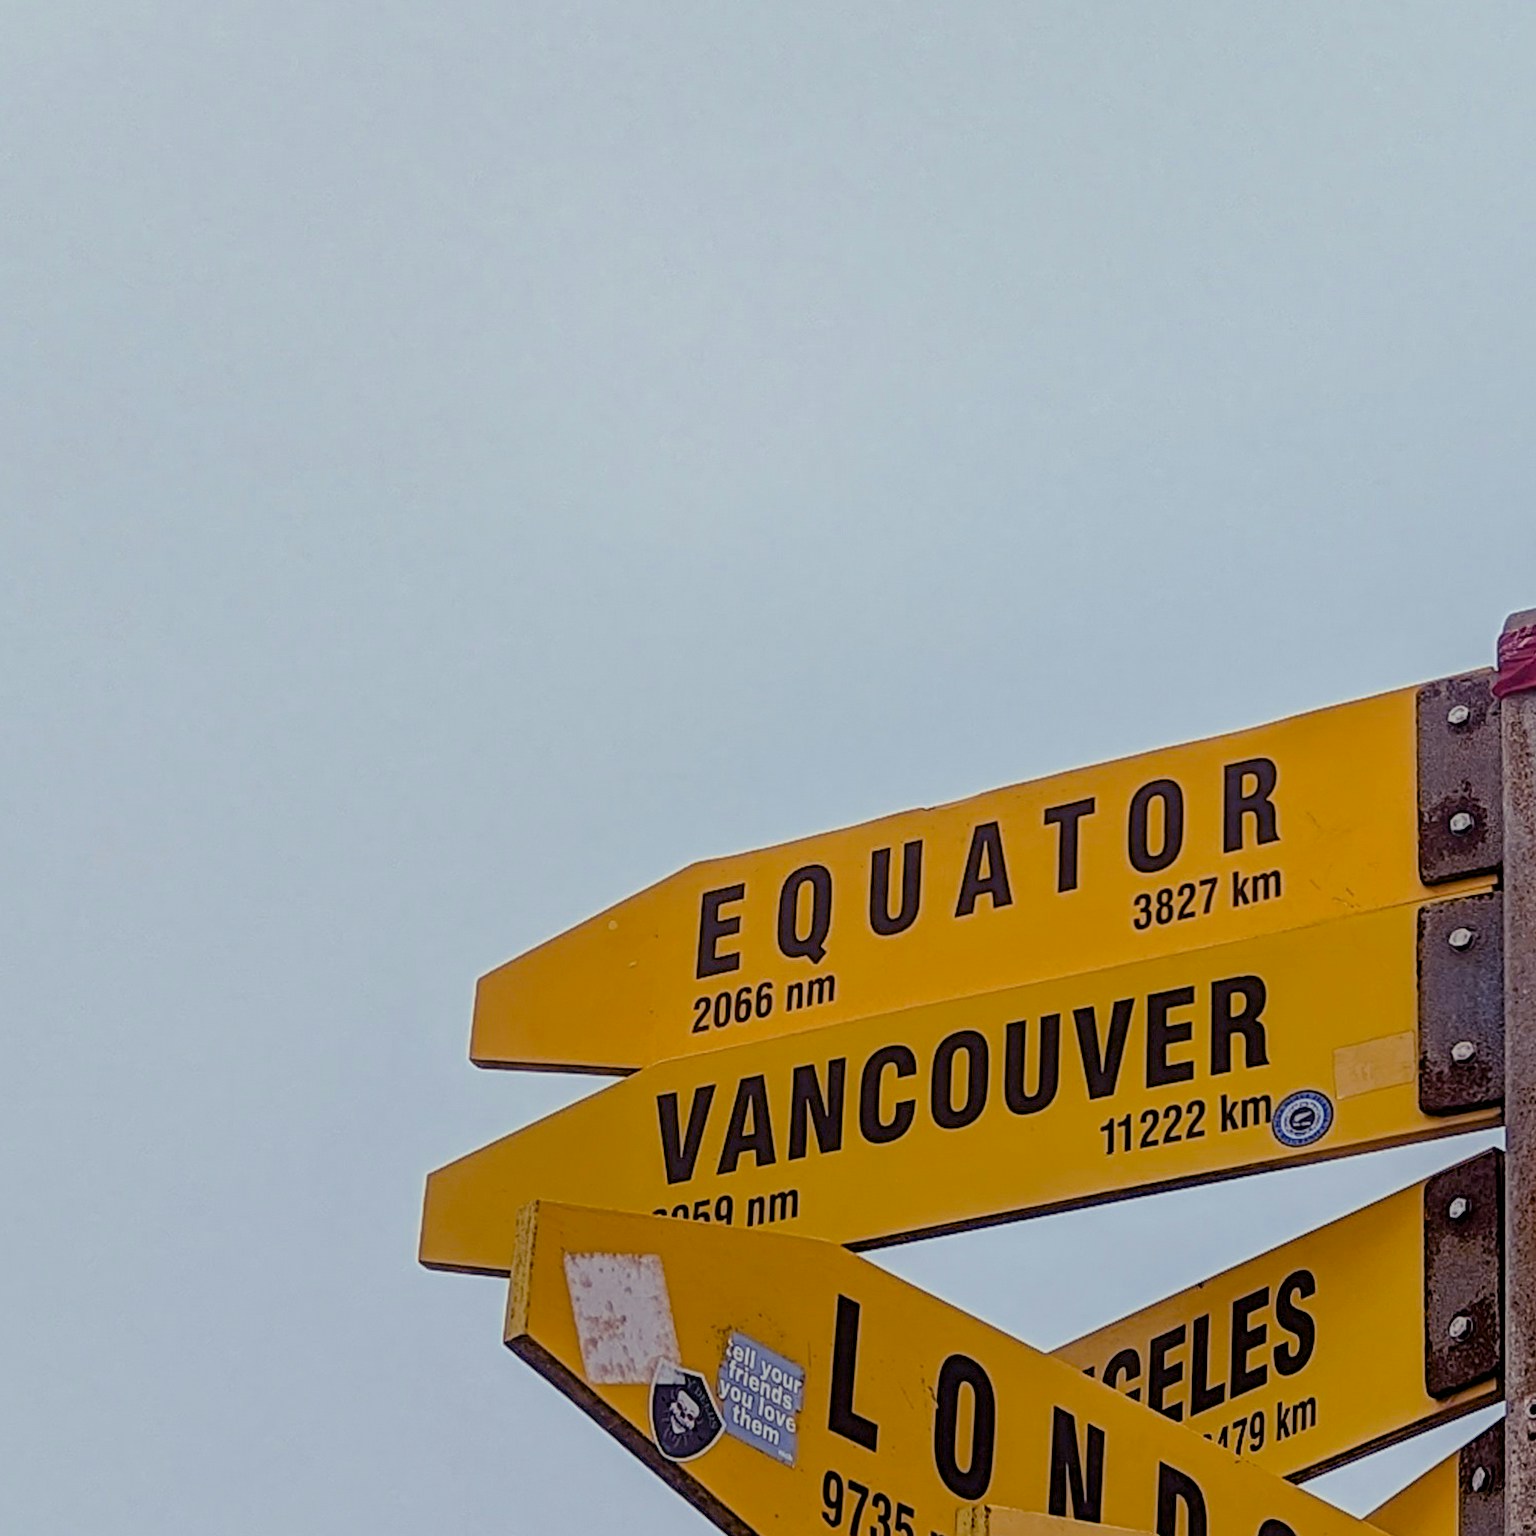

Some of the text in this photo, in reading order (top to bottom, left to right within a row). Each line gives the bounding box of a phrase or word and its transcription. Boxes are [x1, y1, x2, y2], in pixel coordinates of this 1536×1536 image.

[696, 758, 1280, 979] EQUATOR
[1133, 870, 1281, 929] 3827 km
[692, 974, 835, 1033] 2066 nm
[657, 975, 1270, 1185] VANCOUVER
[1100, 1100, 1206, 1155] 11222
[1220, 1094, 1272, 1131] km
[747, 1189, 798, 1227] nm
[728, 1360, 793, 1410] friends
[760, 1360, 802, 1394] your
[718, 1379, 753, 1410] you
[758, 1397, 797, 1433] love
[732, 1405, 780, 1445] them
[1277, 1397, 1316, 1441] km
